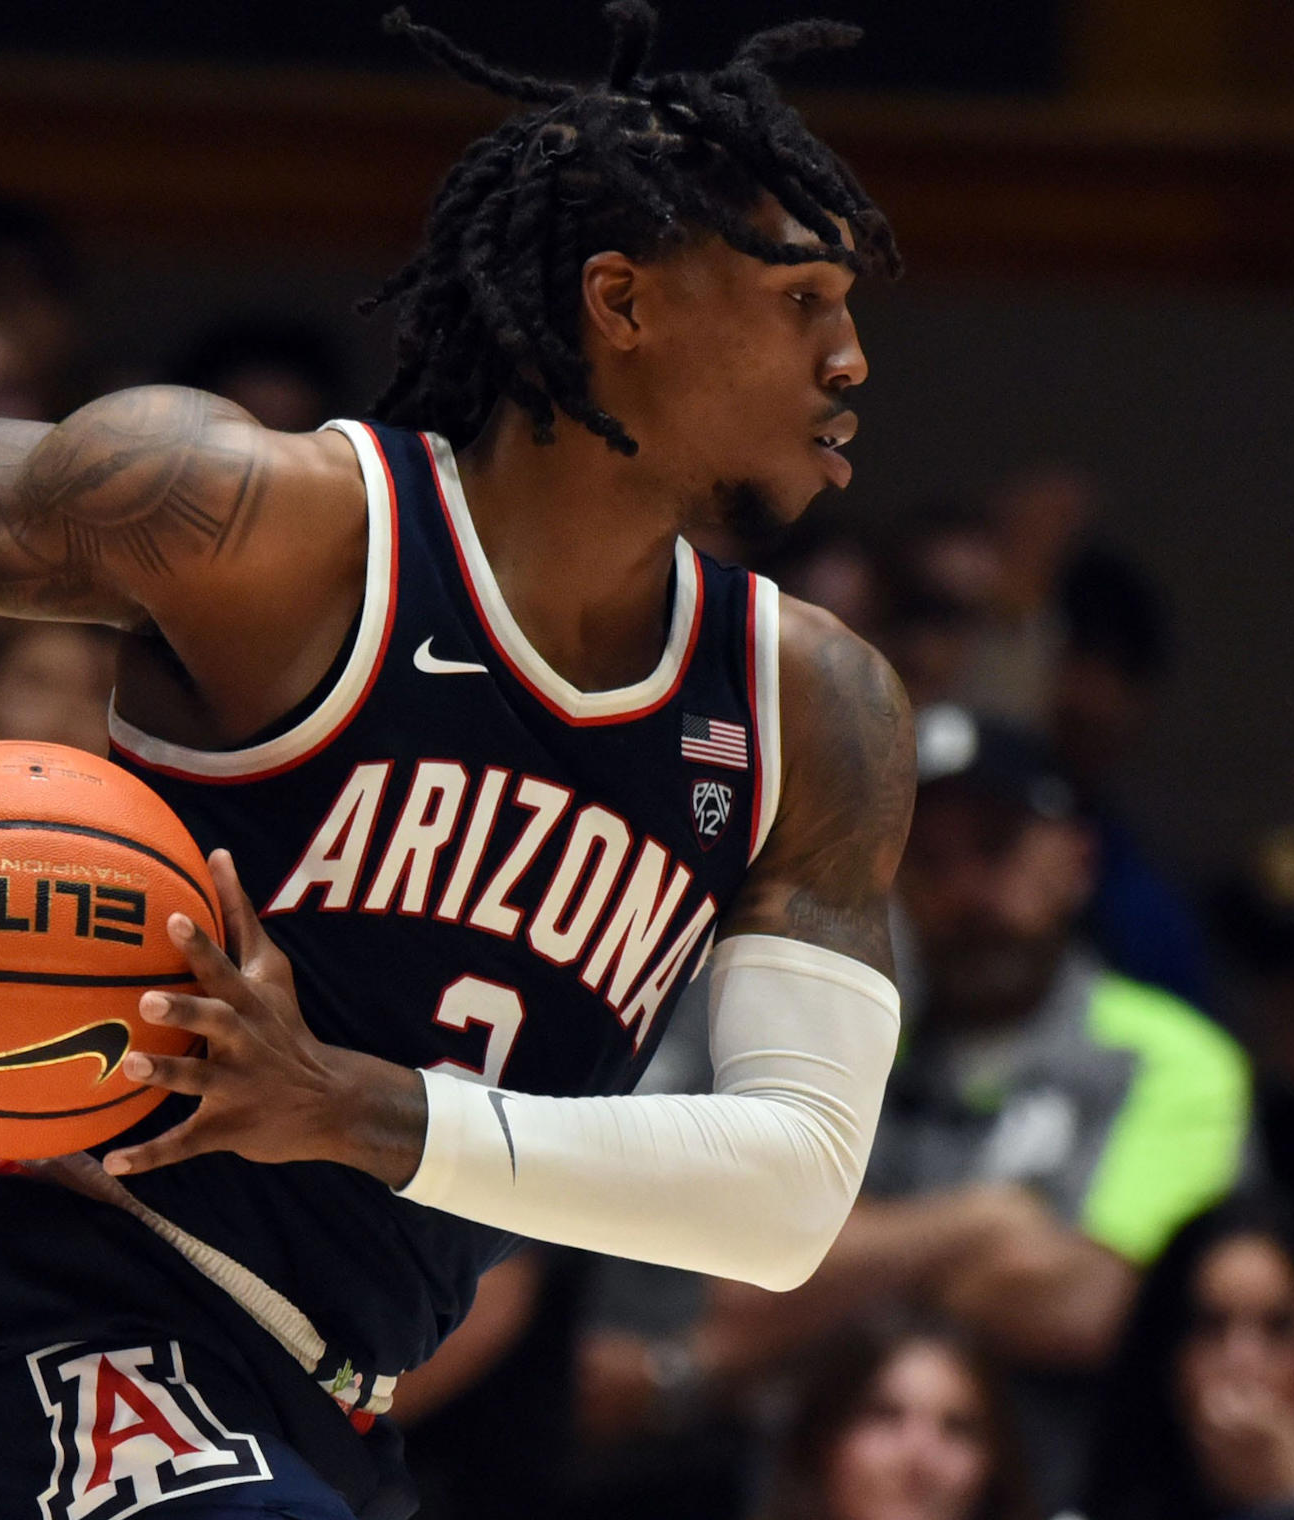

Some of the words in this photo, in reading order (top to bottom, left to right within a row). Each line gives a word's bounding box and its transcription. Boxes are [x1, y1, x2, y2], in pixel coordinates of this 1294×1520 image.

[692, 782, 732, 824] PAC
[698, 810, 721, 836] 12
[261, 758, 718, 1056] ARIZONA
